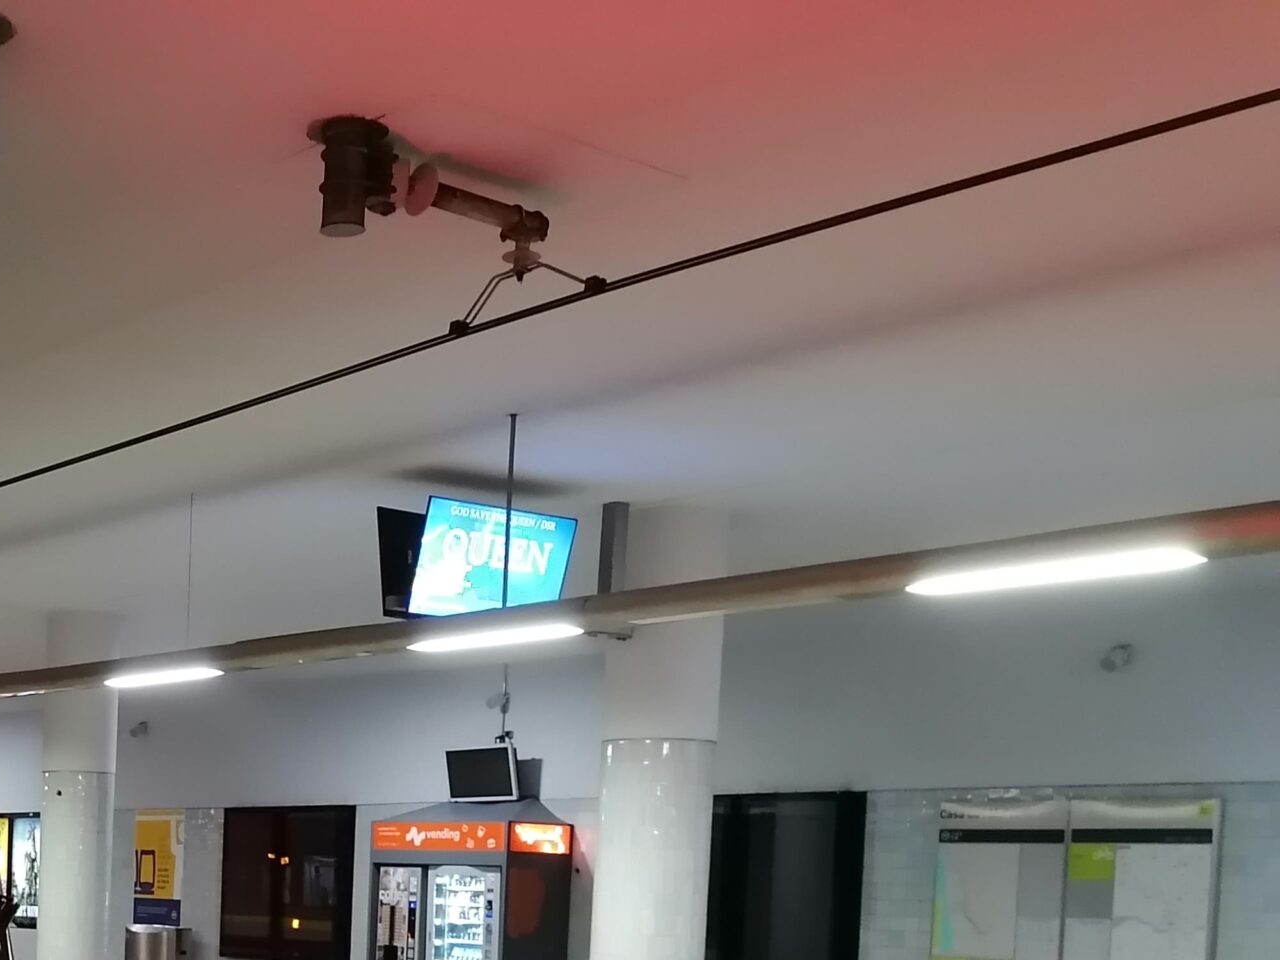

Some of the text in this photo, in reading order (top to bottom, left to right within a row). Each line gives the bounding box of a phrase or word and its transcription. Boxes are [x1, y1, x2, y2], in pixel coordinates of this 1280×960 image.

[451, 505, 470, 517] GOD
[443, 528, 552, 576] QUEEN
[426, 828, 461, 843] vending
